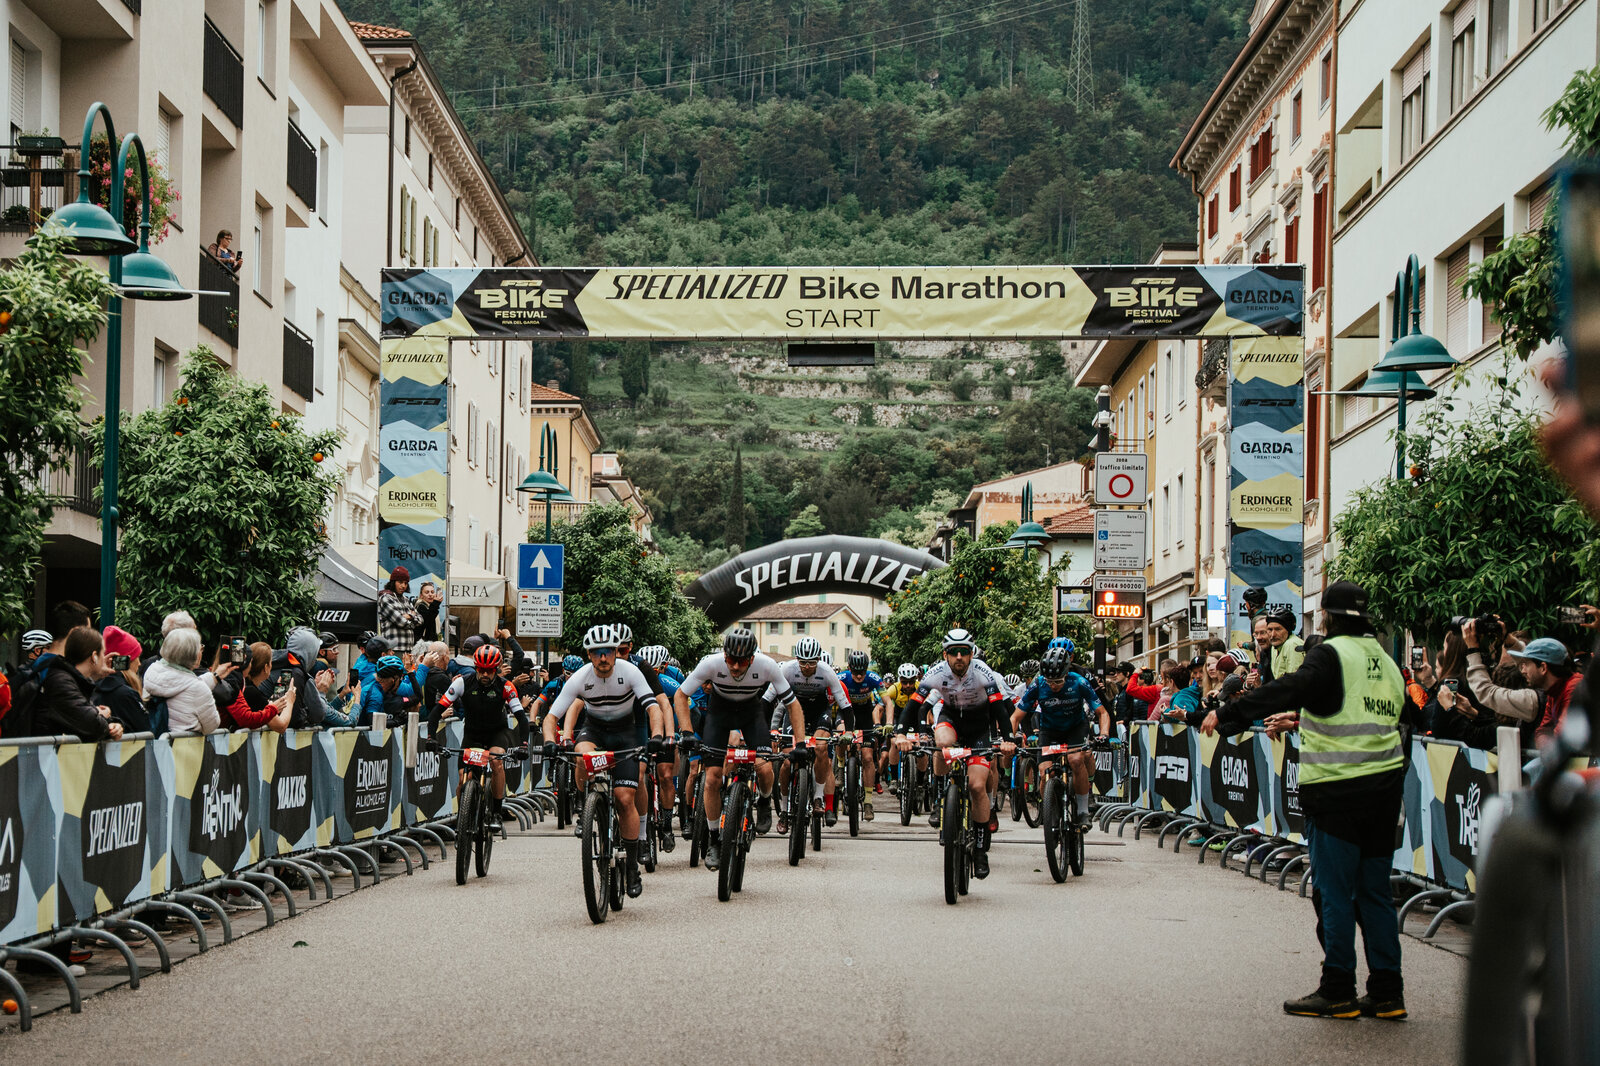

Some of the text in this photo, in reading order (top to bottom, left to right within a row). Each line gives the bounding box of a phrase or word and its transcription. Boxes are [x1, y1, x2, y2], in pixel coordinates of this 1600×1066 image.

[605, 274, 1066, 300] SPECIALIZED Bike Marathon
[388, 291, 448, 306] GARDA
[474, 289, 569, 309] BIKE
[1104, 287, 1203, 307] BIKE
[1230, 289, 1295, 304] GARDA
[494, 310, 547, 319] FESTIVAL
[785, 309, 880, 328] START
[1125, 309, 1180, 317] FESTIVAL
[386, 354, 444, 363] SPECIALIZED
[1238, 354, 1299, 363] SPECIALIZED
[388, 440, 438, 451] GARDA
[1240, 442, 1294, 454] GARDA
[388, 490, 437, 502] ERDINGER
[1240, 494, 1292, 506] ERDINGER
[388, 546, 438, 561] TRENTINO
[1240, 552, 1294, 568] TRENTINO
[734, 551, 924, 604] SPECIALIZE
[313, 610, 350, 622] LIZED
[1097, 604, 1142, 617] ATTIVO
[414, 751, 440, 782] GARDA
[1220, 755, 1249, 789] GARDA
[277, 774, 307, 810] MAXXIS
[1228, 790, 1244, 802] TRENTINO
[86, 802, 143, 858] SPECIALIZED
